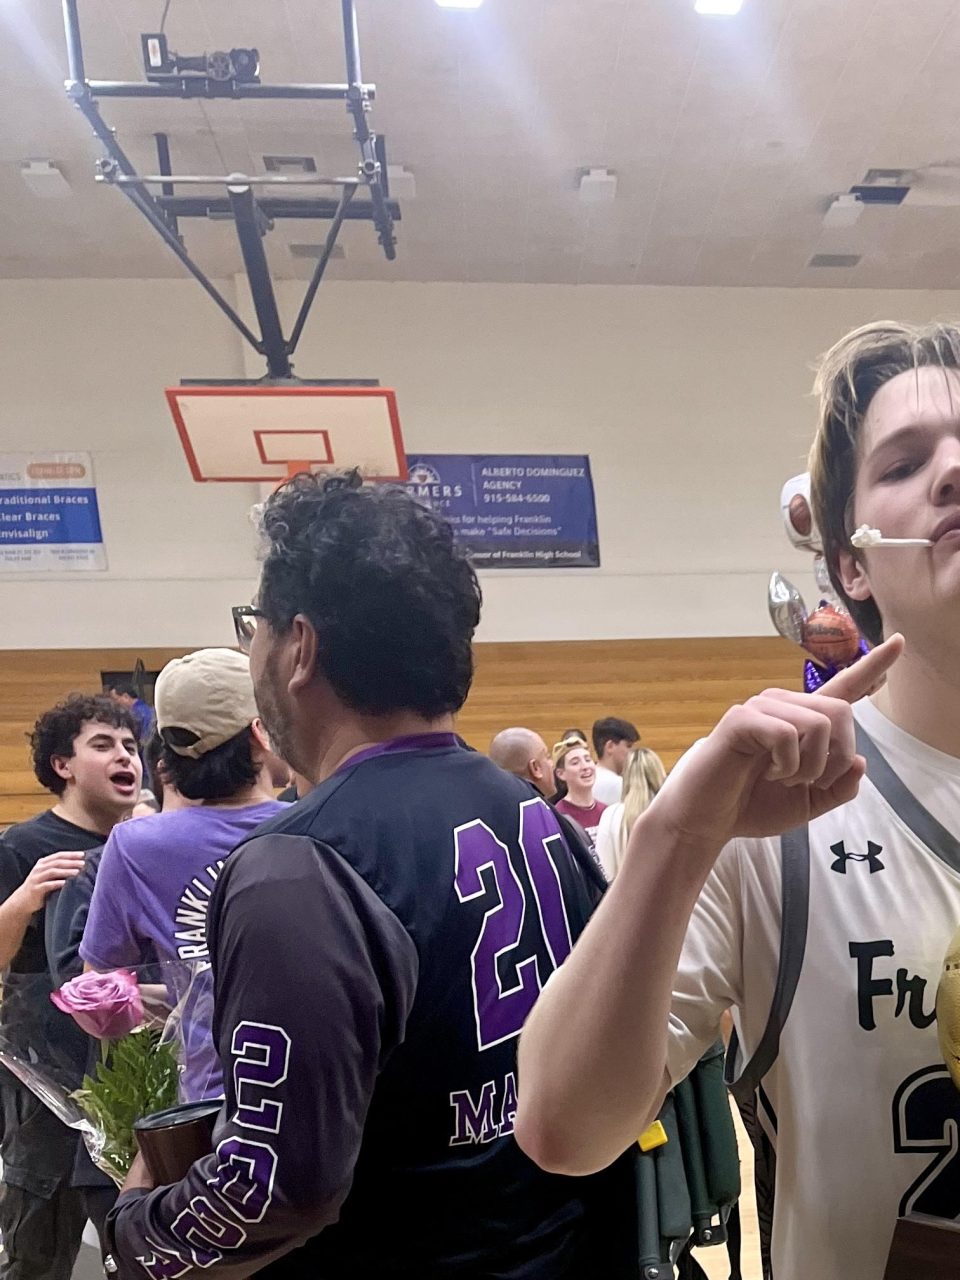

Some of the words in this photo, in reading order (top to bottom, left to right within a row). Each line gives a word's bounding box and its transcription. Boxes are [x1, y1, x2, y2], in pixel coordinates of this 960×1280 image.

[481, 467, 524, 477] ALBERTO
[526, 468, 585, 477] DOMINGUEZ
[483, 481, 522, 490] AGENCY
[53, 495, 89, 504] Braces
[0, 512, 22, 521] lear
[26, 512, 60, 521] Braces
[462, 515, 475, 523] for
[477, 515, 513, 525] helping
[514, 515, 551, 523] Franklin
[0, 529, 48, 540] nvisalign
[536, 551, 554, 560] High
[555, 551, 582, 559] School
